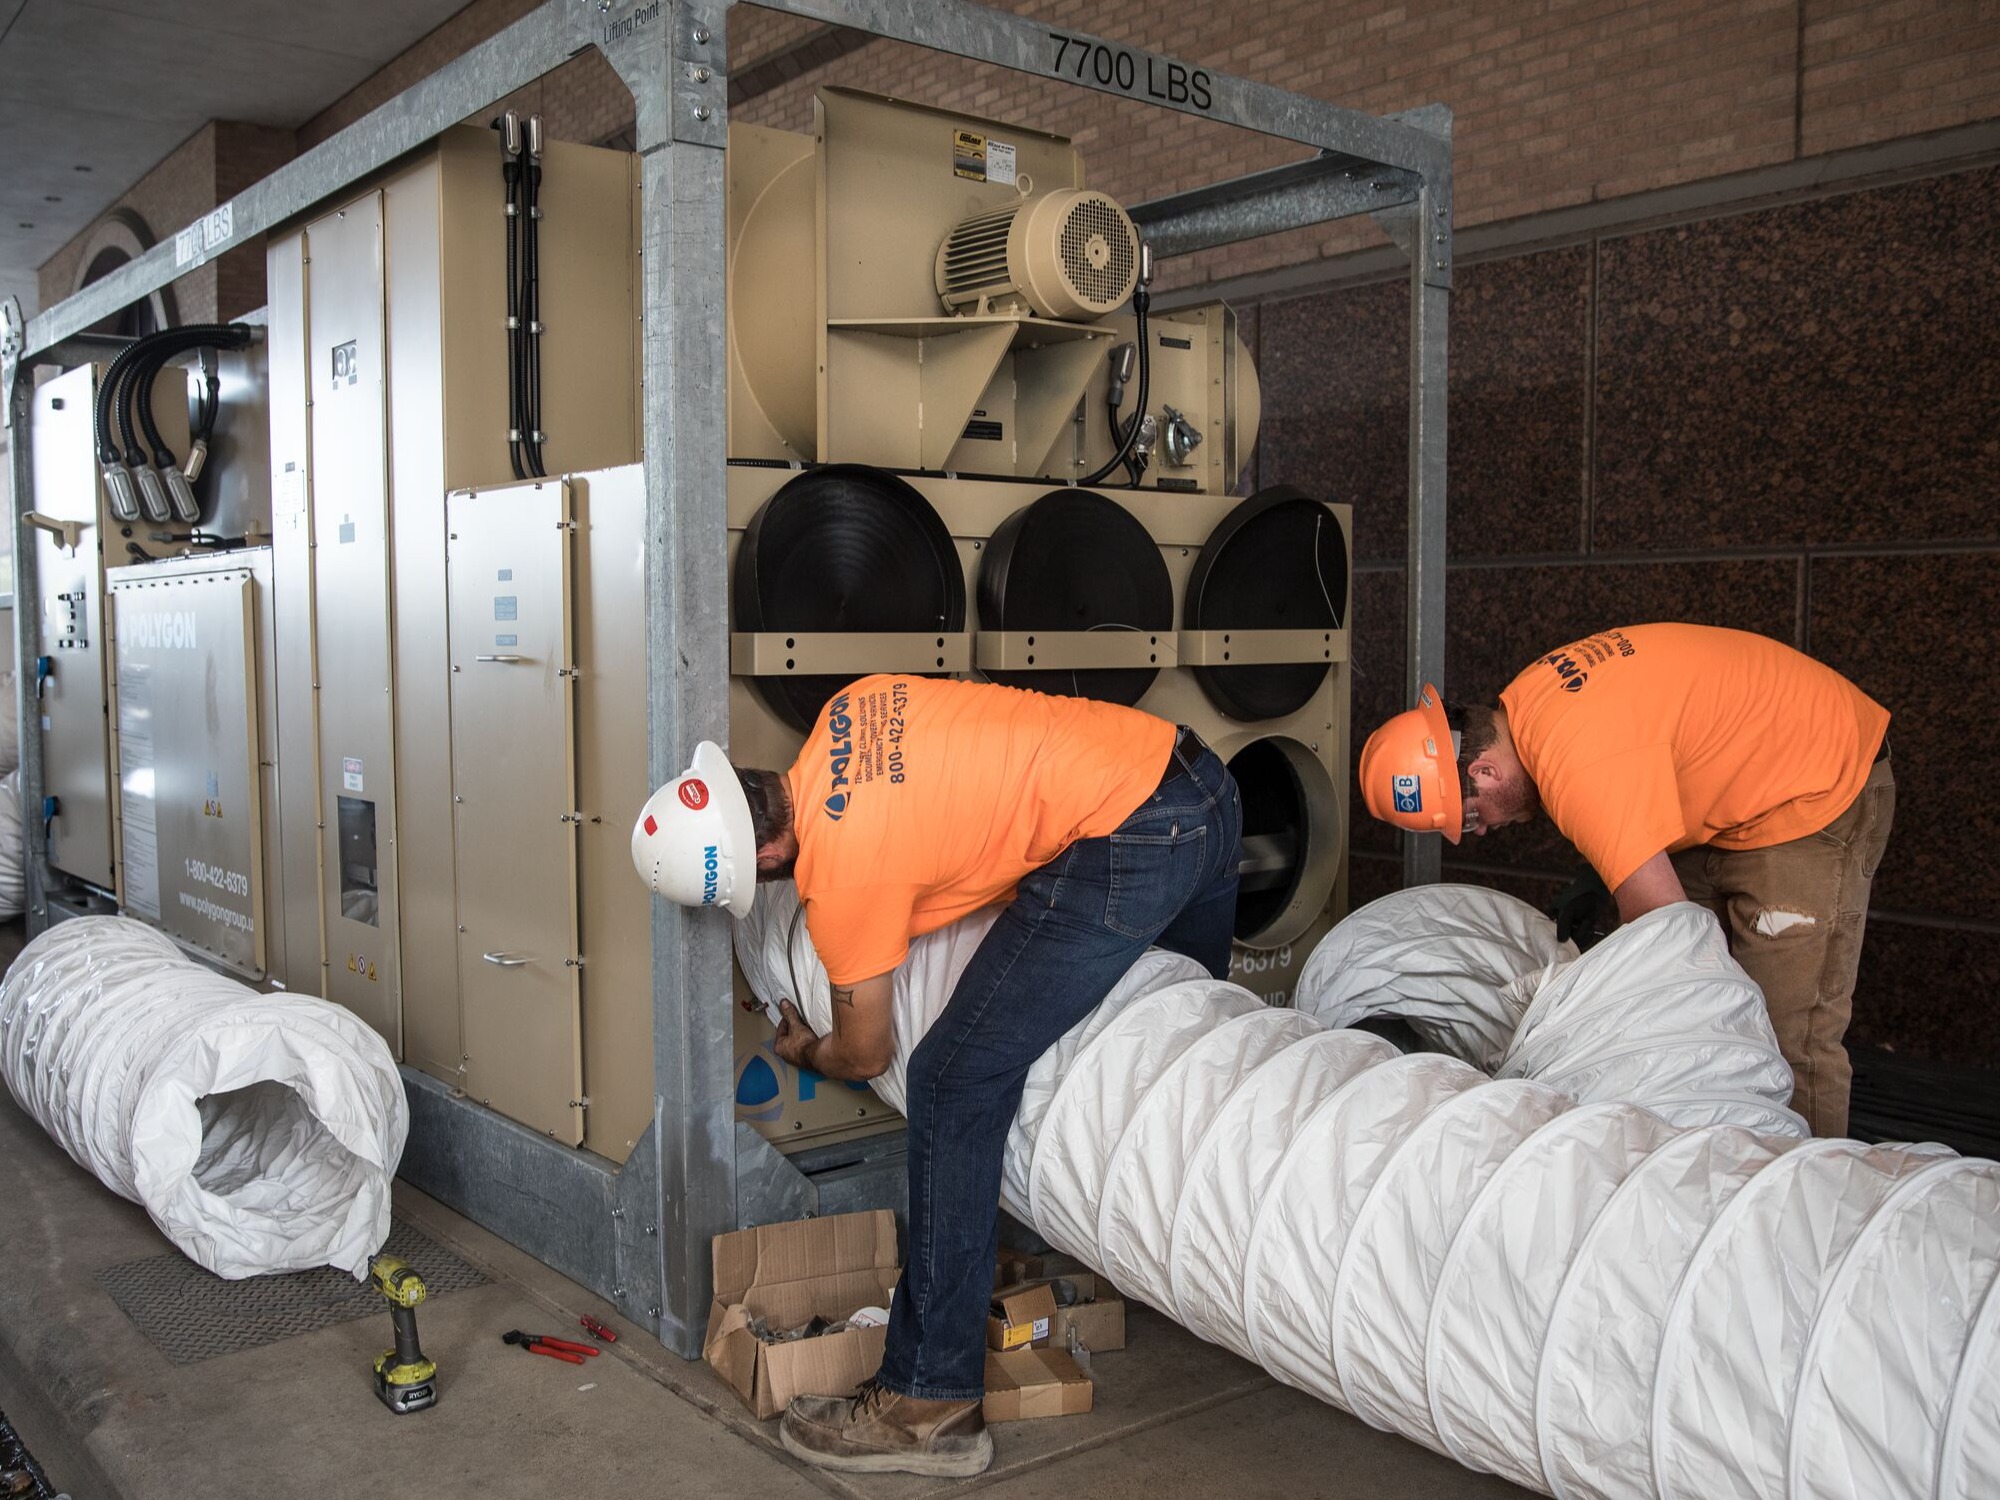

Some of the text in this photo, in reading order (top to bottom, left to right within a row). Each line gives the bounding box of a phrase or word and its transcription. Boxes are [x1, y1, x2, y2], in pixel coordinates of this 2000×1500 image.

[603, 0, 659, 45] Lifting Point
[1049, 32, 1213, 111] 7700 LBS
[207, 206, 230, 246] LBS
[130, 611, 197, 649] POLYGON
[888, 682, 908, 785] 800-422-6379
[184, 857, 249, 897] 1-800-422-6379
[702, 845, 718, 904] POLYGON
[1228, 945, 1292, 976] -6379
